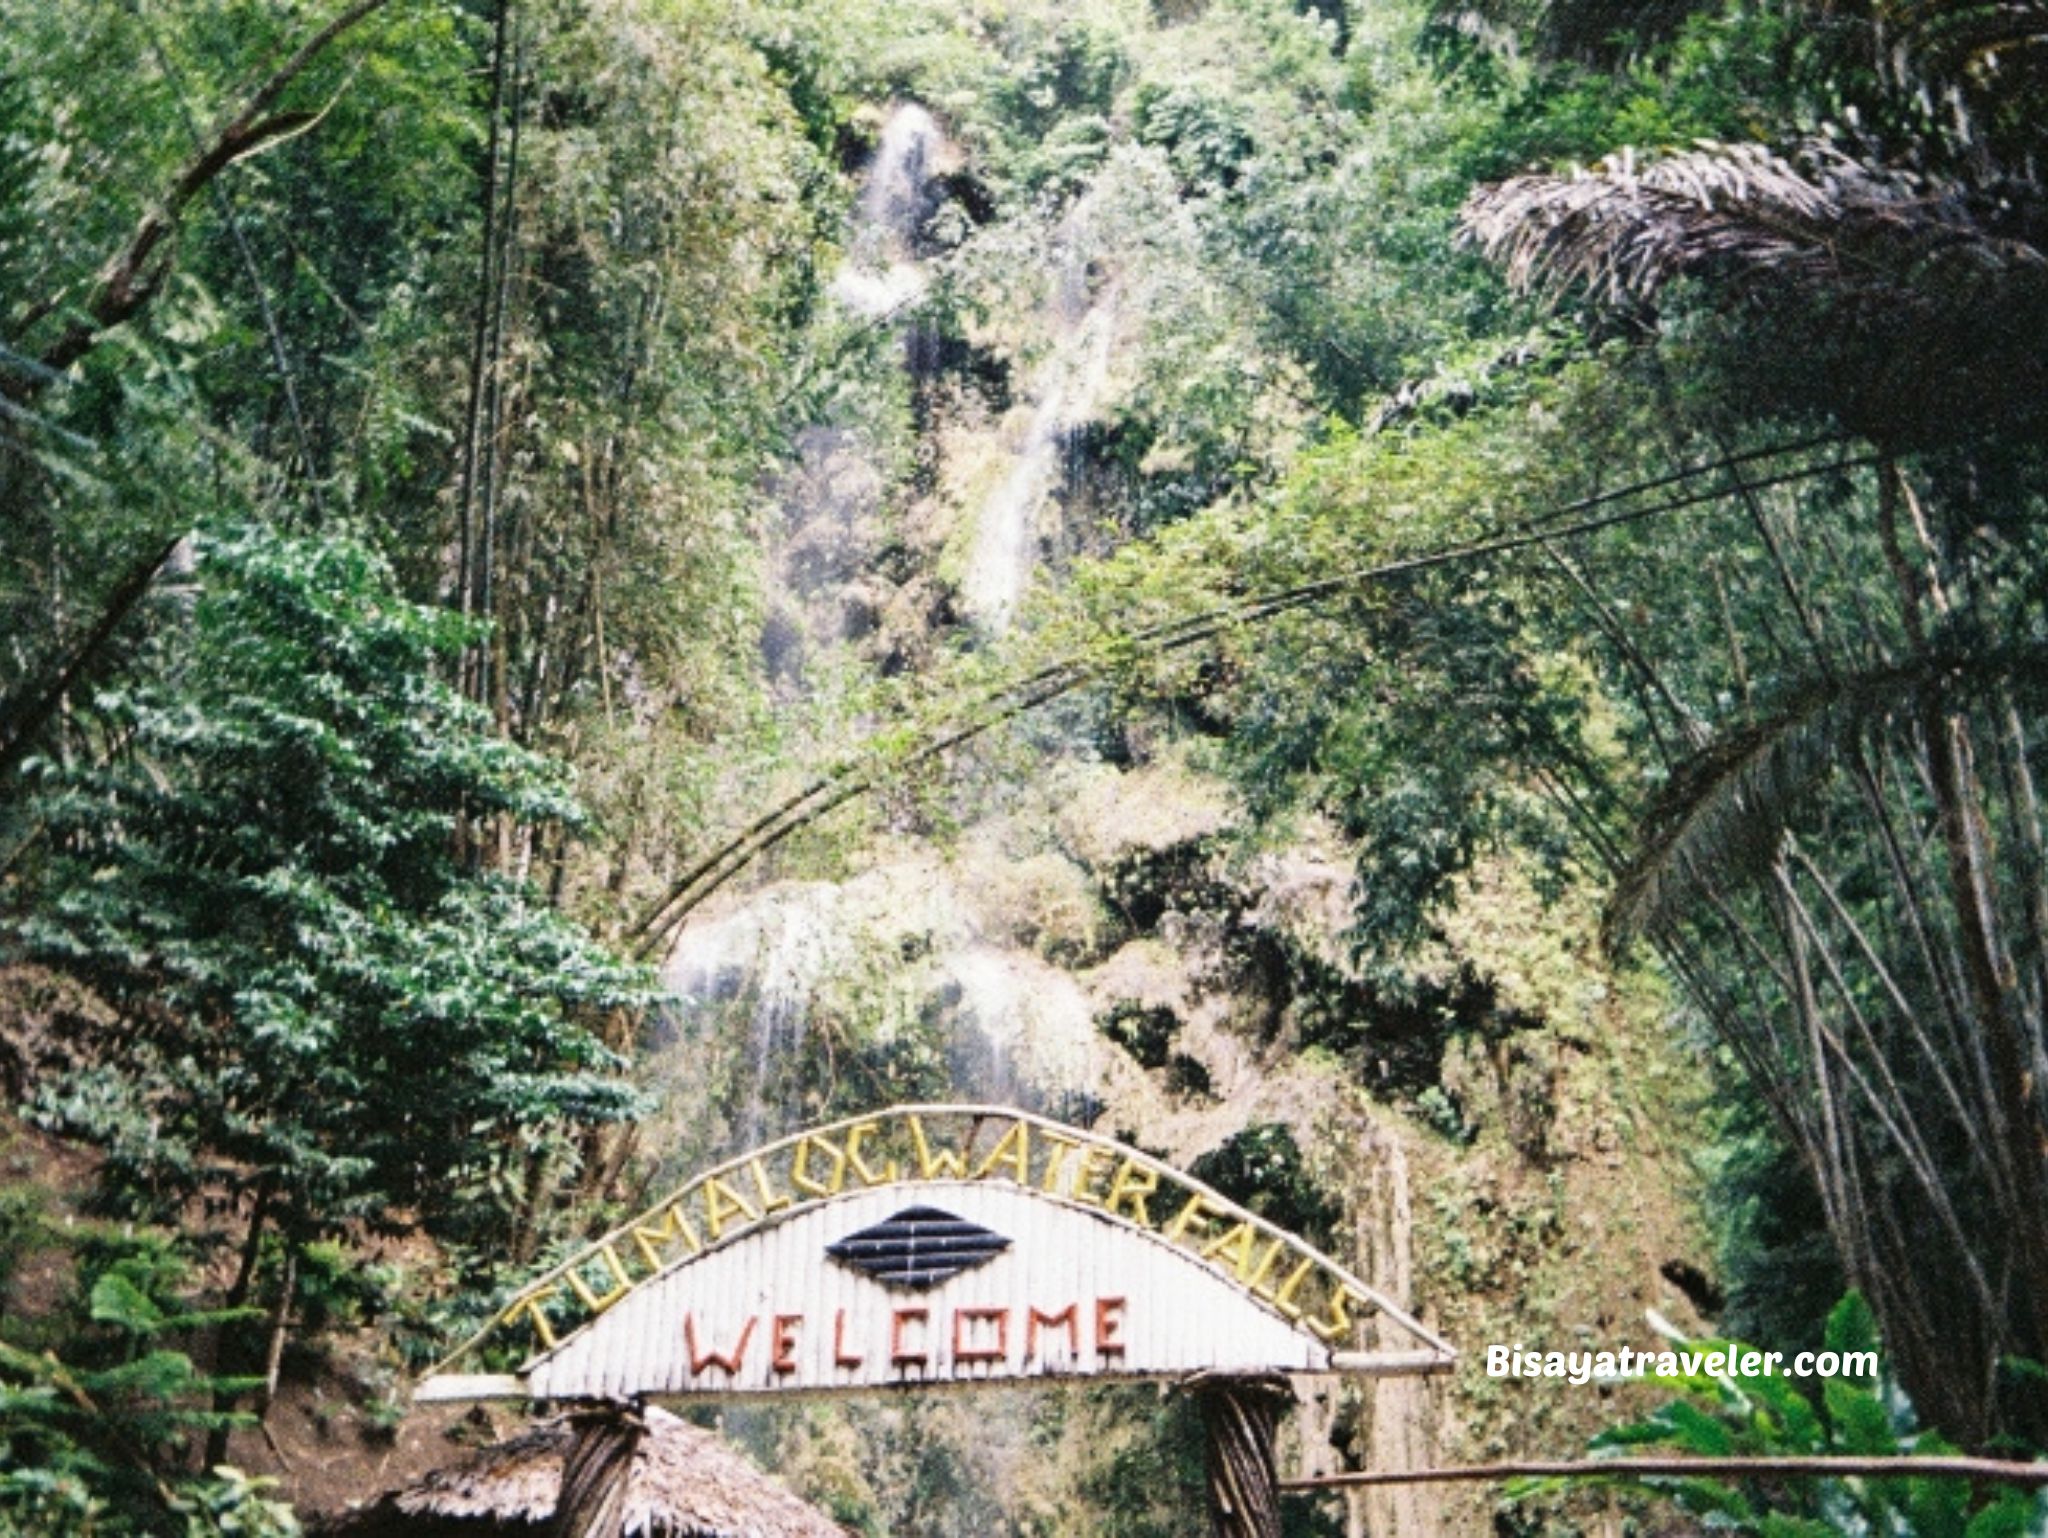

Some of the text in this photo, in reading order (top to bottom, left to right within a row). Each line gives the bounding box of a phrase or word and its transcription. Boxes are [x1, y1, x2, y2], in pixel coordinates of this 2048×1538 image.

[909, 1114, 1158, 1227] WATER
[1169, 1196, 1368, 1338] FALLS
[684, 1297, 1126, 1376] WELCOME
